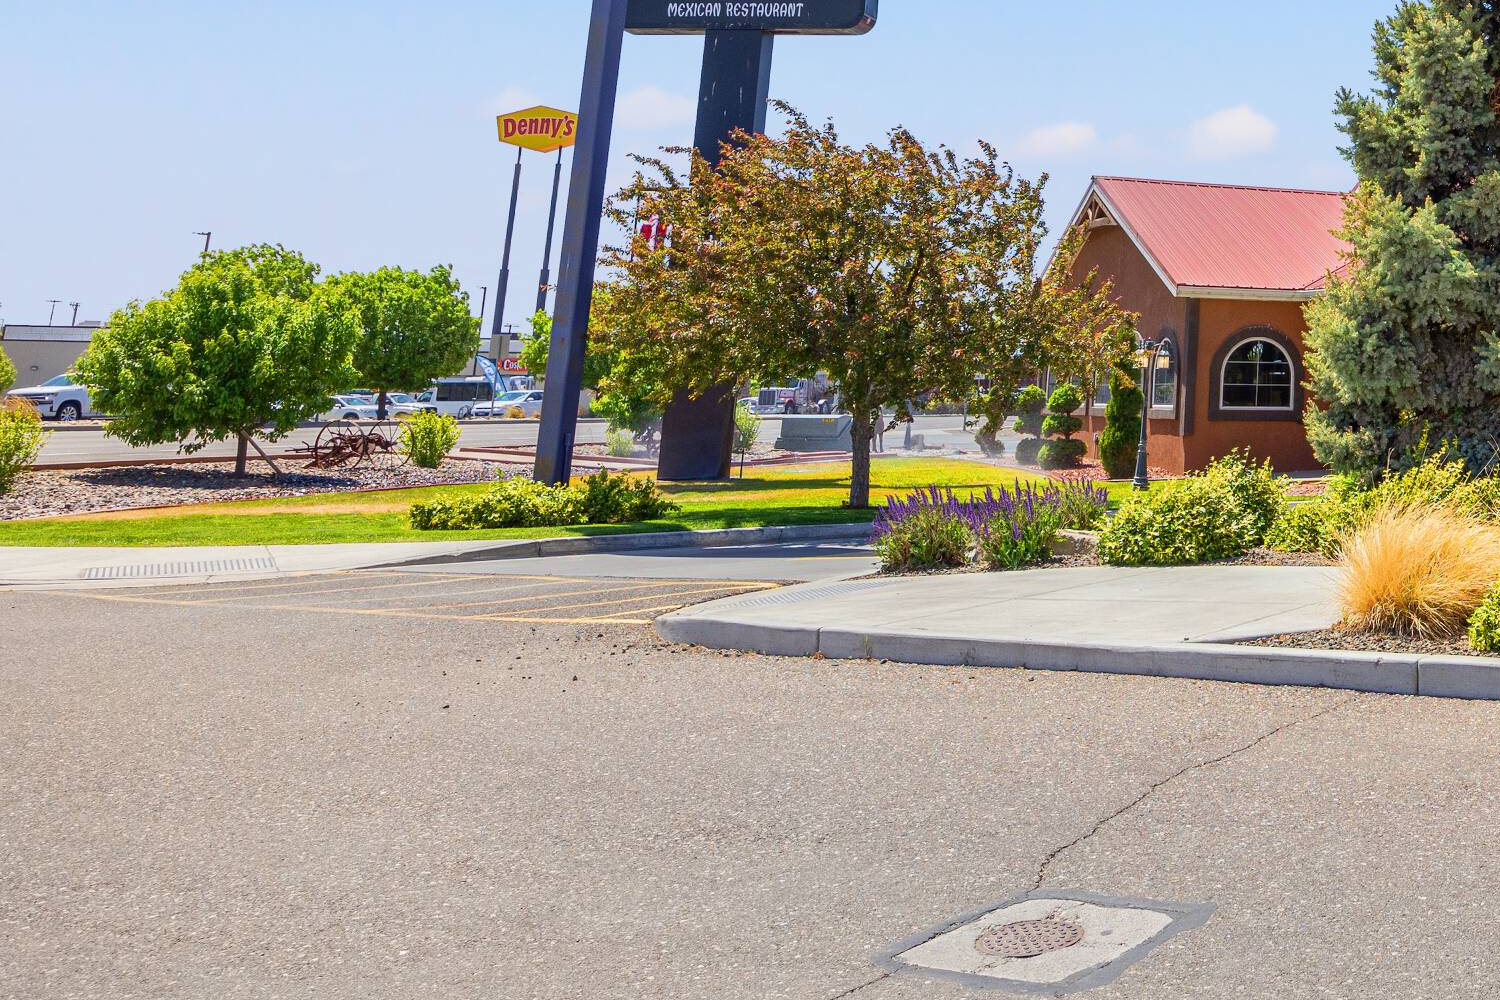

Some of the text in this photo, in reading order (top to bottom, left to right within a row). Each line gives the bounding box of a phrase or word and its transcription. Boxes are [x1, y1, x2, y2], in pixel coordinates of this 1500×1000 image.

[667, 2, 804, 17] MEXICAN RESTAURANT
[503, 115, 575, 138] Denny's
